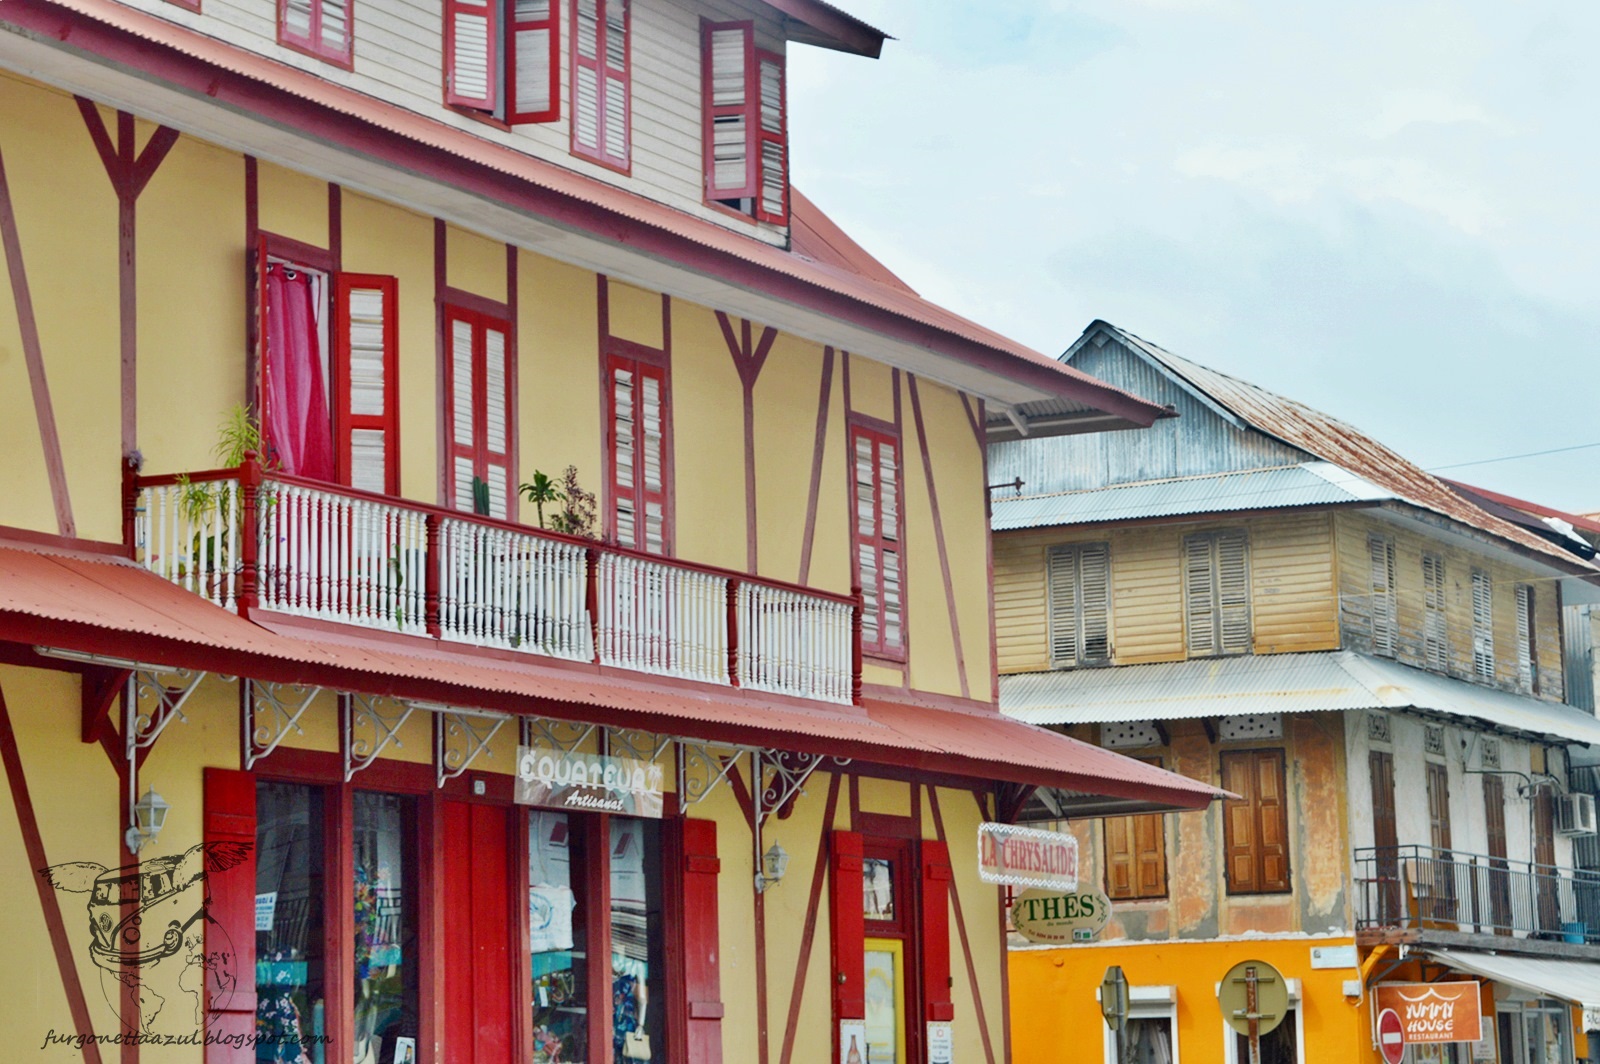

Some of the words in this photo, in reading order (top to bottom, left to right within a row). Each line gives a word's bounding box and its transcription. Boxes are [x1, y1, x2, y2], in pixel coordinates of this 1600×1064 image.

[565, 789, 624, 811] Artisanat
[981, 835, 997, 867] LA
[1002, 838, 1075, 877] CHRYSALIDE
[1023, 892, 1095, 921] THÉS
[1406, 1001, 1454, 1020] YUMMY
[1407, 1020, 1454, 1032] HOUSE
